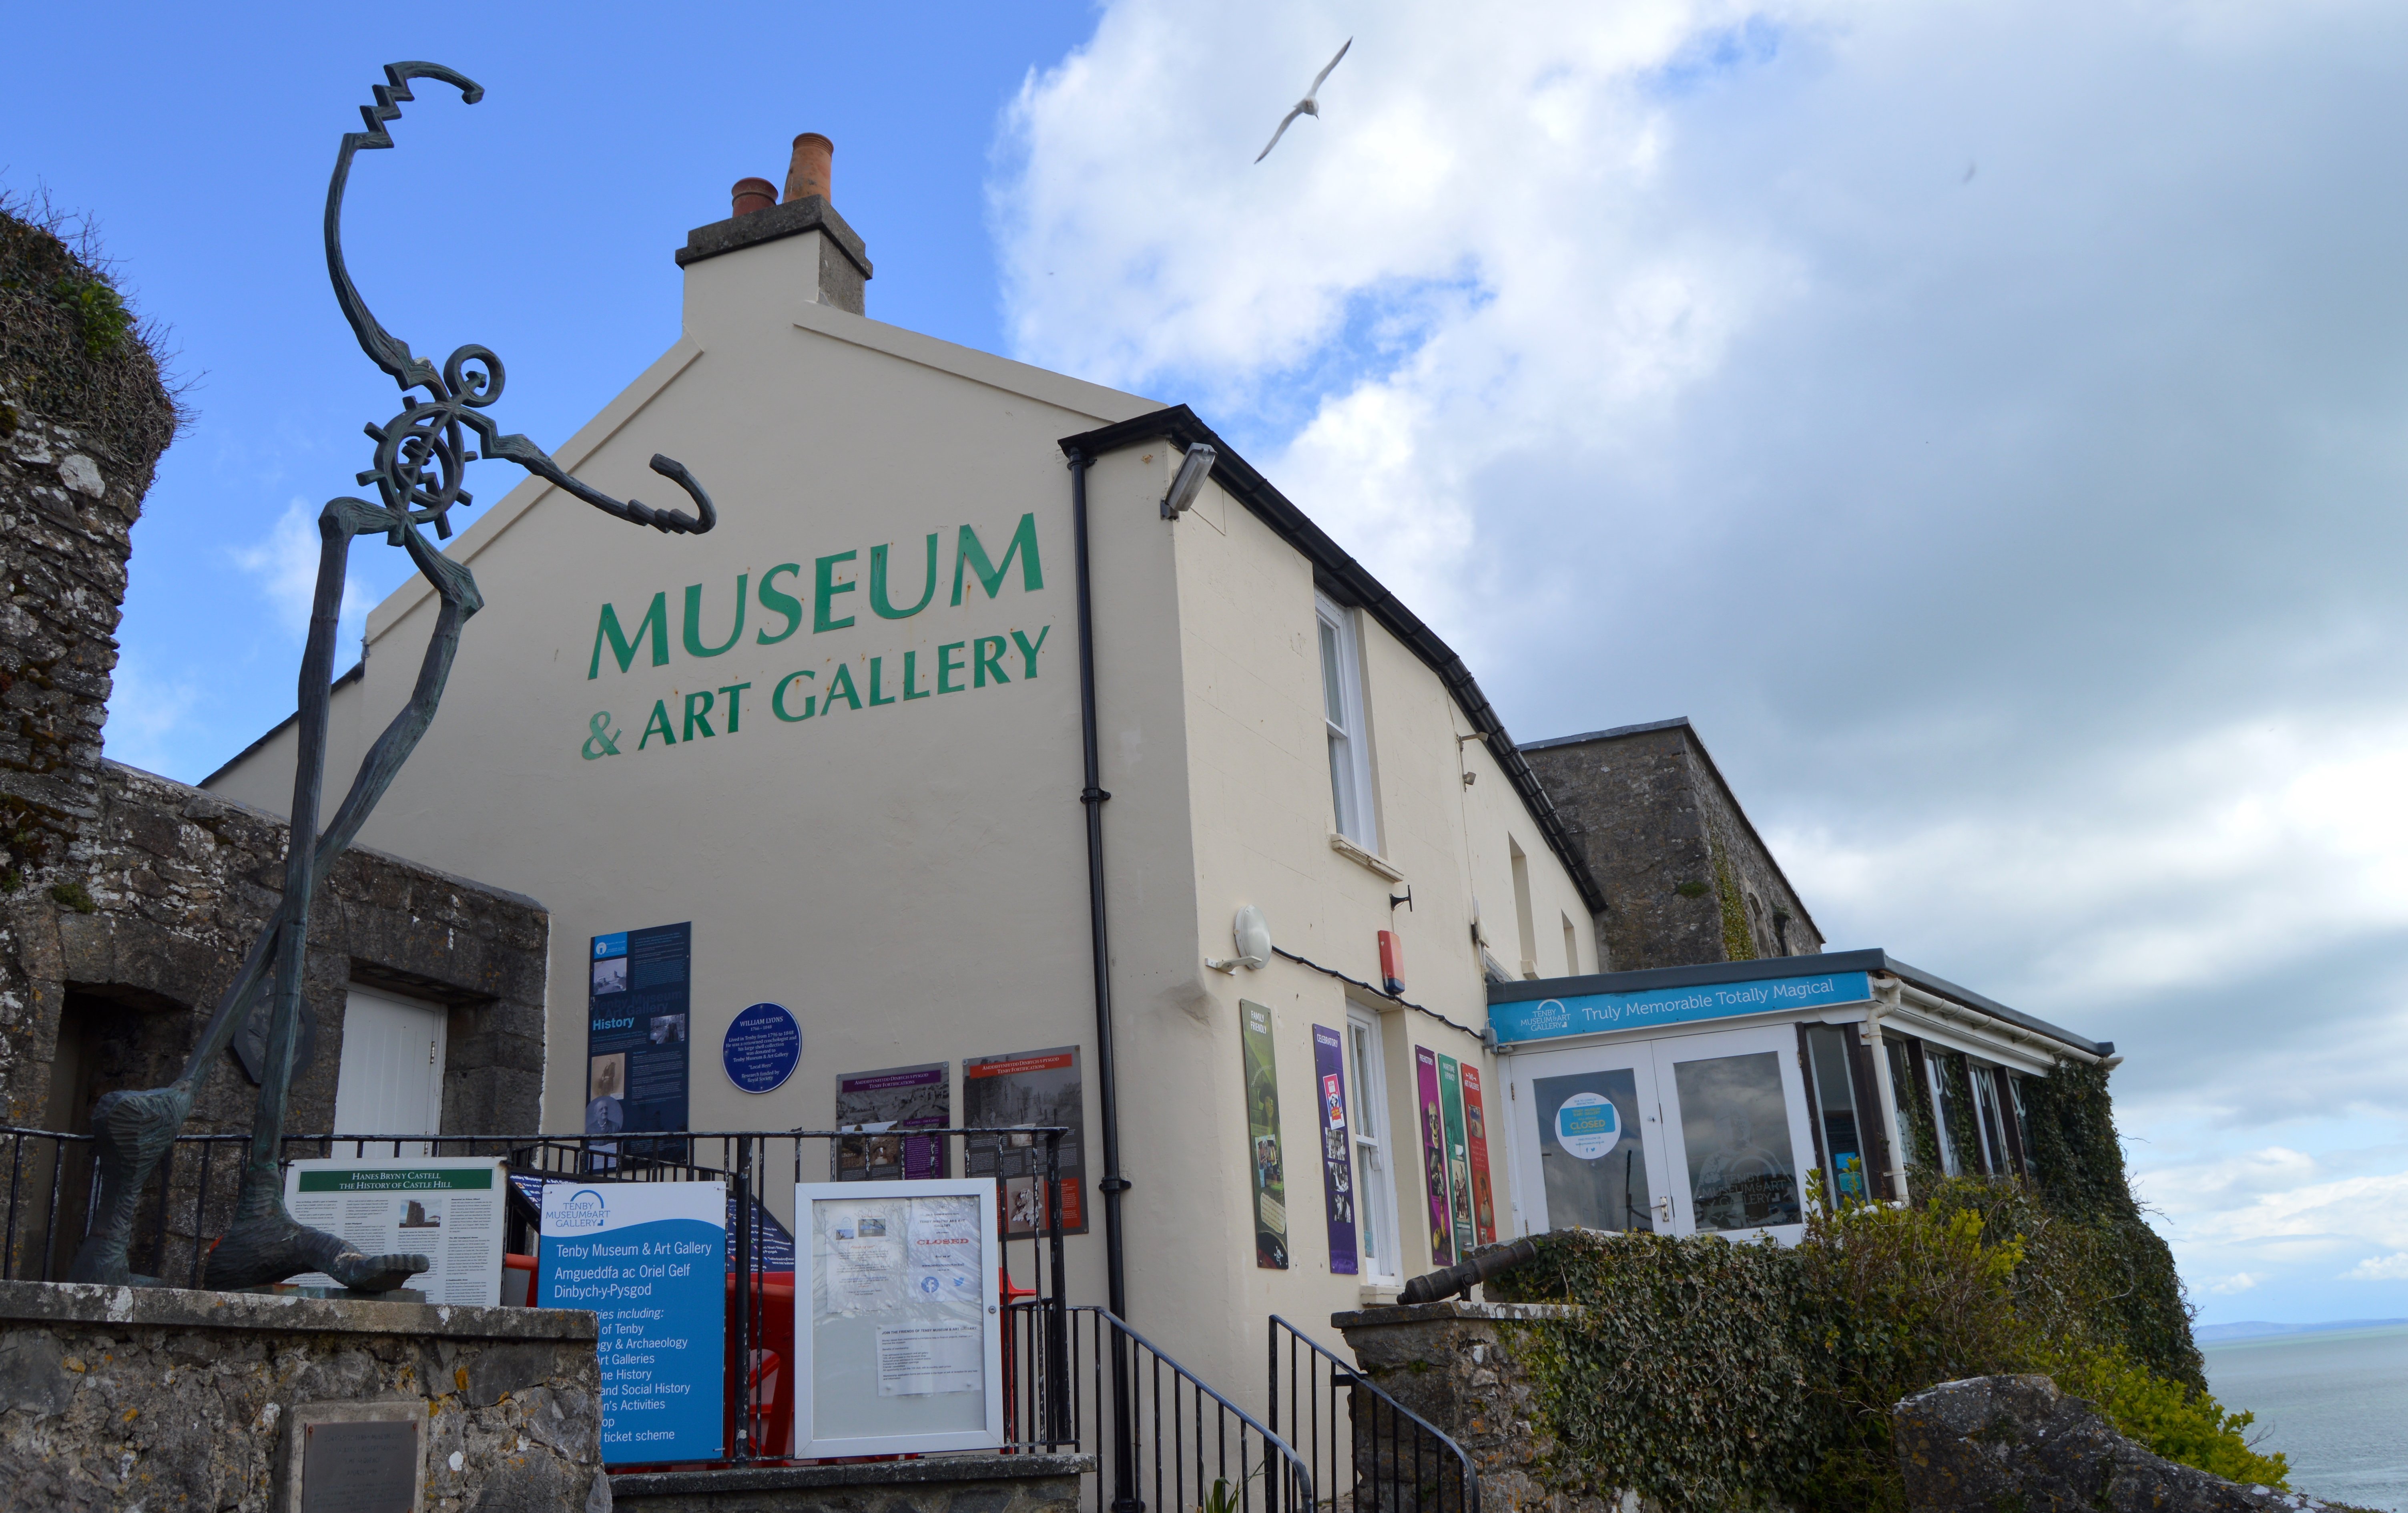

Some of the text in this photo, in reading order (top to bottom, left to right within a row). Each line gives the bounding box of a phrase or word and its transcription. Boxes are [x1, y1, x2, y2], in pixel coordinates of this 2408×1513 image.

[588, 512, 1044, 681] MUSEUM
[582, 625, 1051, 760] & ART GALLERY
[1582, 979, 1834, 1021] Truly Memorable Totally Magical
[626, 1003, 668, 1016] Gallery
[1533, 1009, 1556, 1017] TENBY
[740, 1019, 765, 1027] WILLIAM
[1251, 1011, 1264, 1023] FAMILY
[593, 1017, 634, 1031] History
[1250, 1021, 1266, 1034] FRIENDLY
[1531, 1022, 1562, 1031] GALLERY
[1317, 1033, 1338, 1048] CELEBRATORY
[1419, 1053, 1433, 1065] PREHISTORY
[1011, 1064, 1045, 1072] FORTIFICATIONS
[1443, 1062, 1455, 1073] MARITIME
[1570, 1119, 1605, 1130] CLOSED
[407, 1171, 441, 1179] CASTELL
[1722, 1171, 1760, 1184] TENBY
[356, 1181, 391, 1190] HISTORY
[546, 1210, 611, 1219] MUSEUM&ART
[556, 1219, 597, 1227] GALLERY
[556, 1242, 712, 1259] Tenby Museum & Art Gallery
[555, 1264, 690, 1282] Amgueddfa ac Oriel Gelf
[555, 1283, 651, 1300] Dinbych-y-Pysgod
[597, 1308, 664, 1320] ries including:
[602, 1323, 644, 1335] of Tenby
[616, 1339, 623, 1349] &
[626, 1337, 688, 1349] Archaeology
[612, 1353, 654, 1364] Galleries
[616, 1369, 652, 1381] History
[601, 1383, 690, 1396] and Social History
[621, 1399, 665, 1411] Activities
[604, 1430, 675, 1443] ticket scheme
